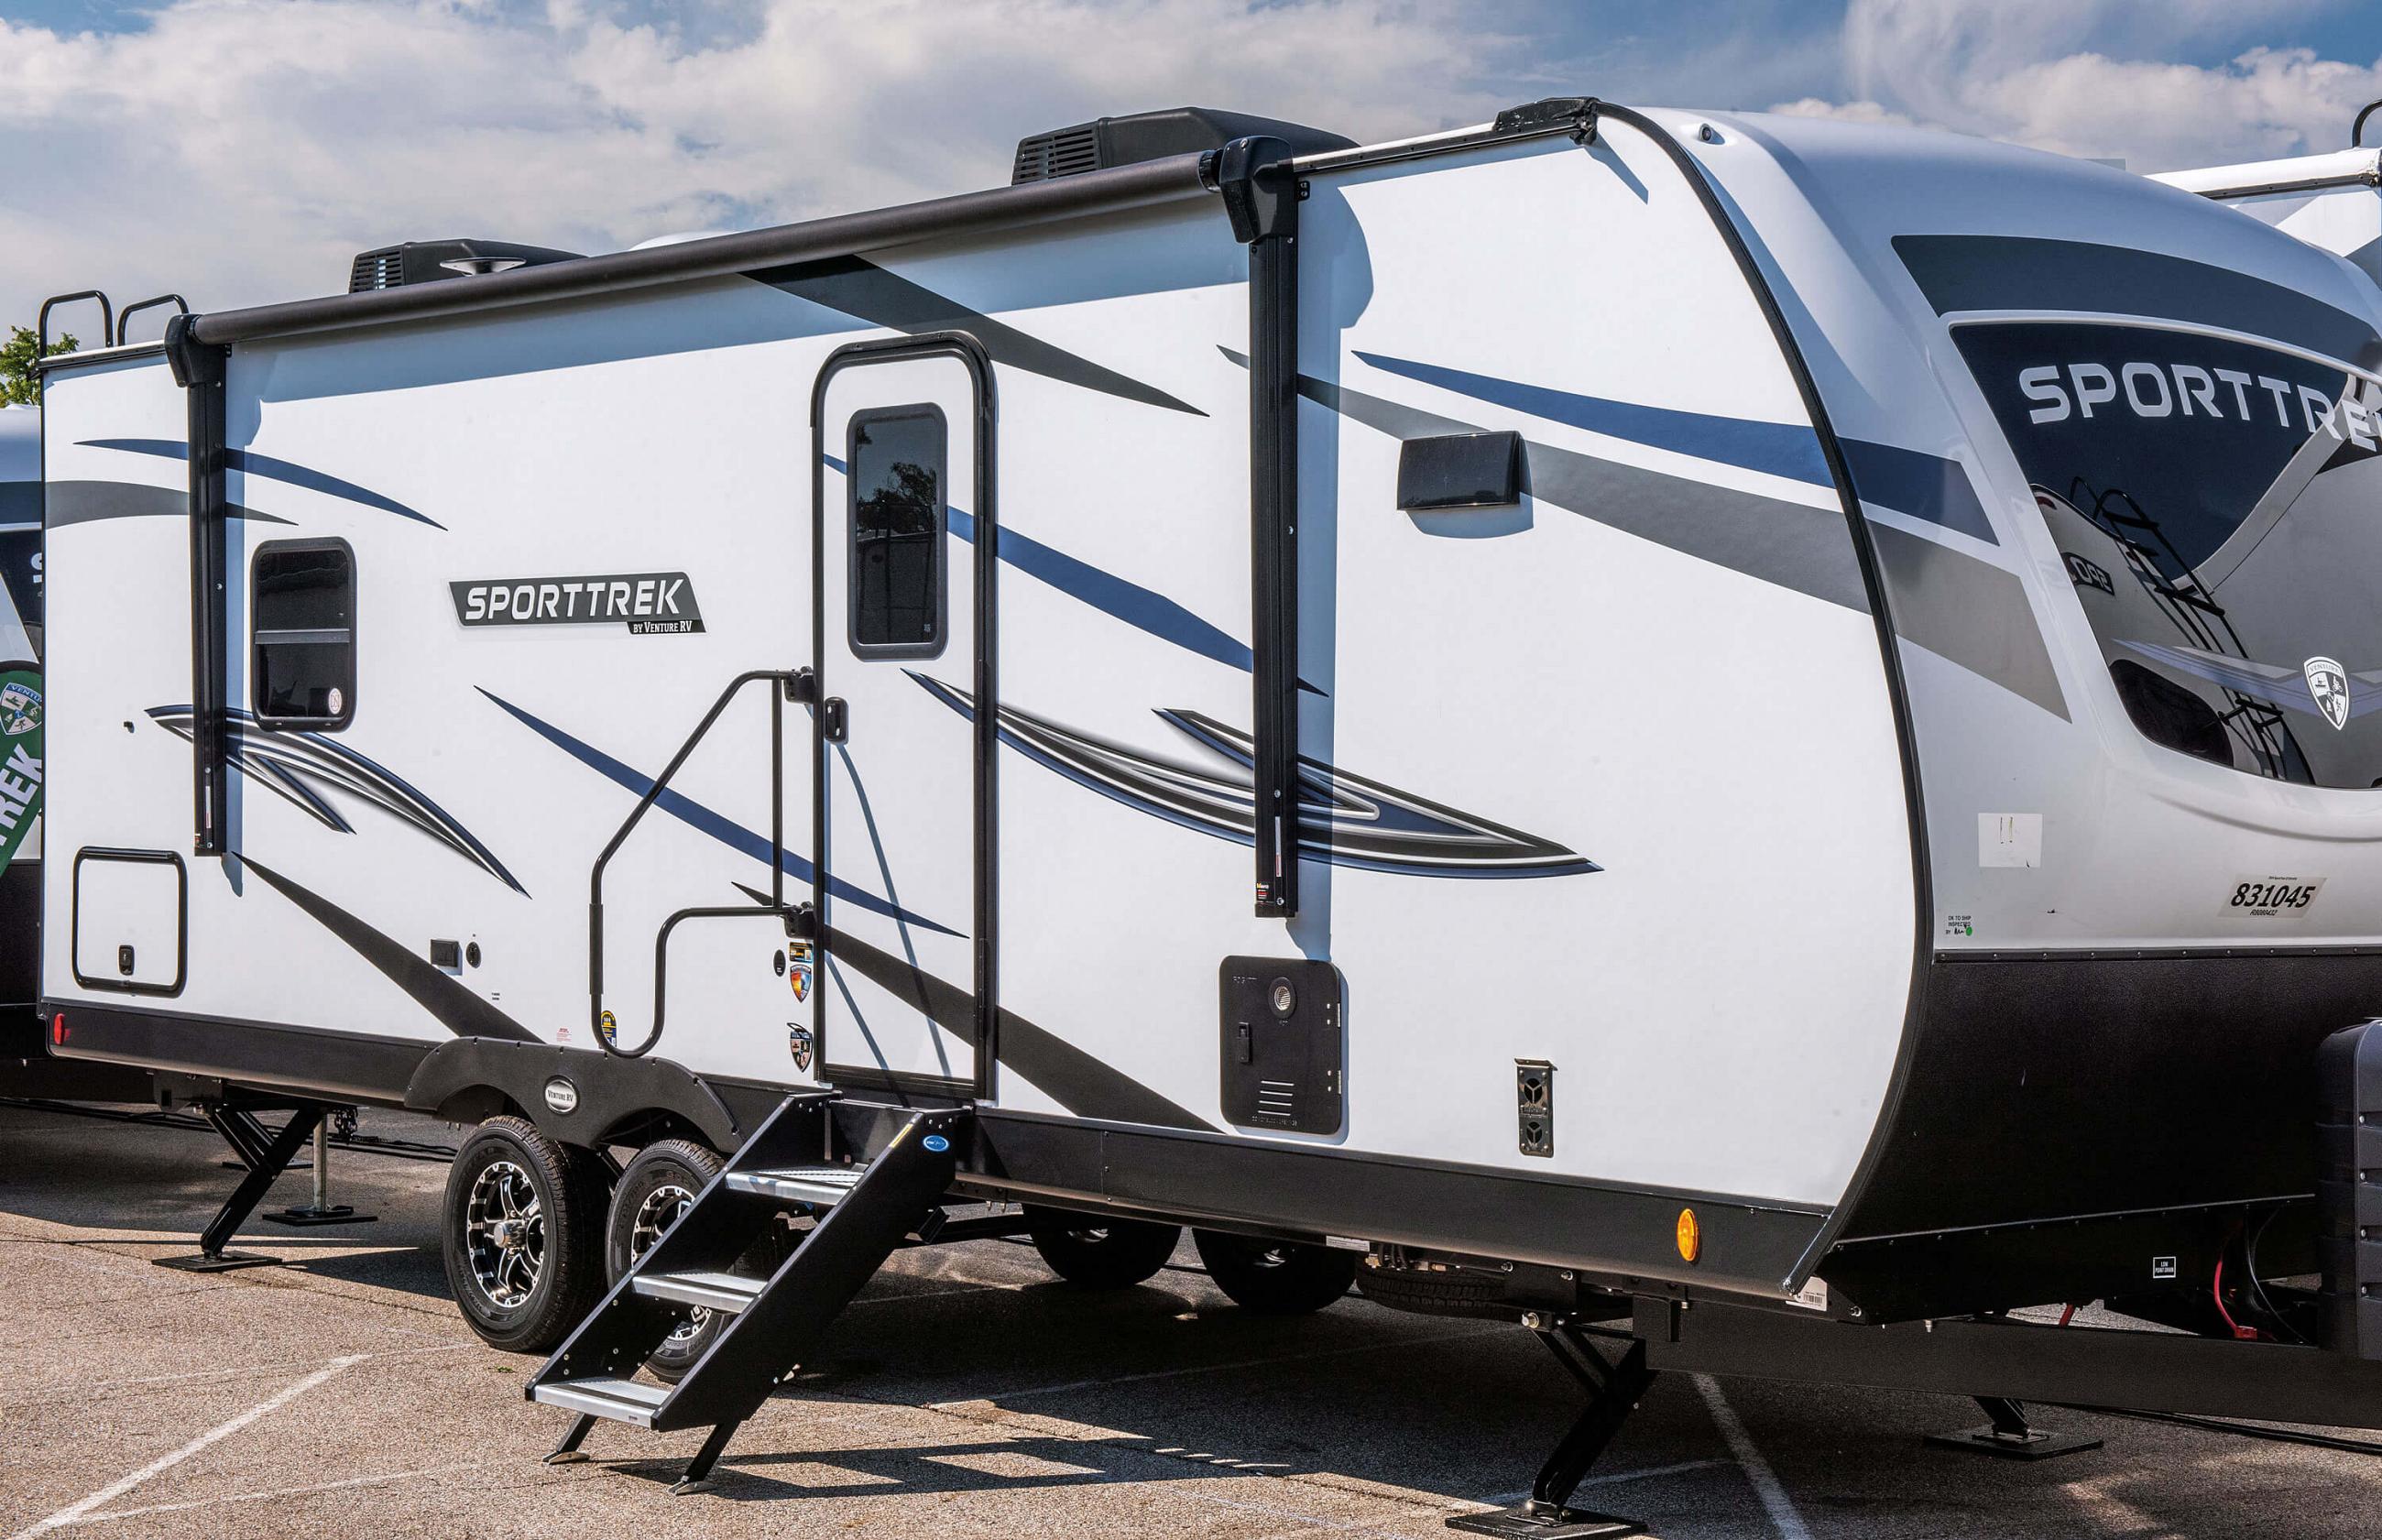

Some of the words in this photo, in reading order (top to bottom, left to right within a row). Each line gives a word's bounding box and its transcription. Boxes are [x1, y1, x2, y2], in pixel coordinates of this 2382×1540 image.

[465, 578, 684, 620] SPORTTREK
[633, 624, 643, 633] BY
[680, 620, 693, 632] RV
[12, 685, 42, 702] VENTU
[0, 743, 42, 846] REK
[2230, 883, 2316, 908] 831045
